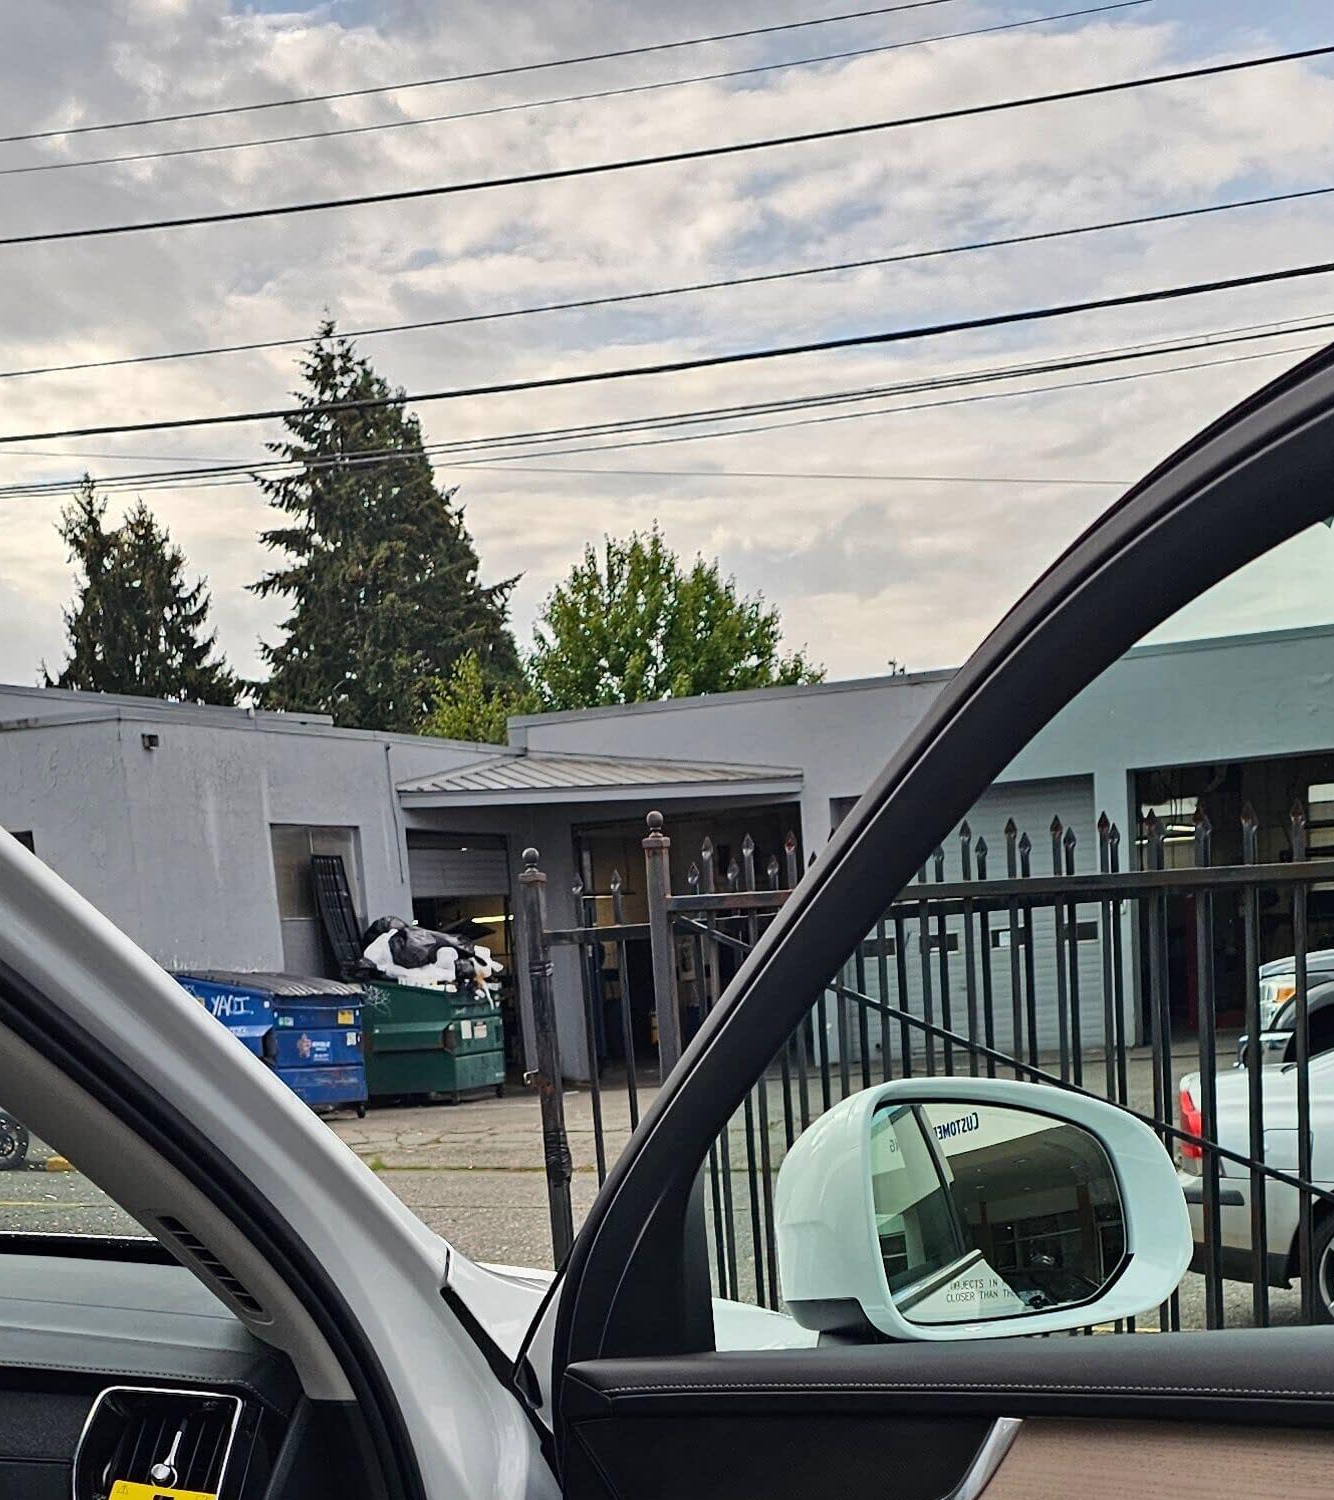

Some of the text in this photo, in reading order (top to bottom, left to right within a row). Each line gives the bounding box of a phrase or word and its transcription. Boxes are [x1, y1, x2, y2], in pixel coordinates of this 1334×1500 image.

[988, 1278, 999, 1288] IN
[946, 1291, 976, 1303] CLOSER
[979, 1289, 999, 1300] THAN
